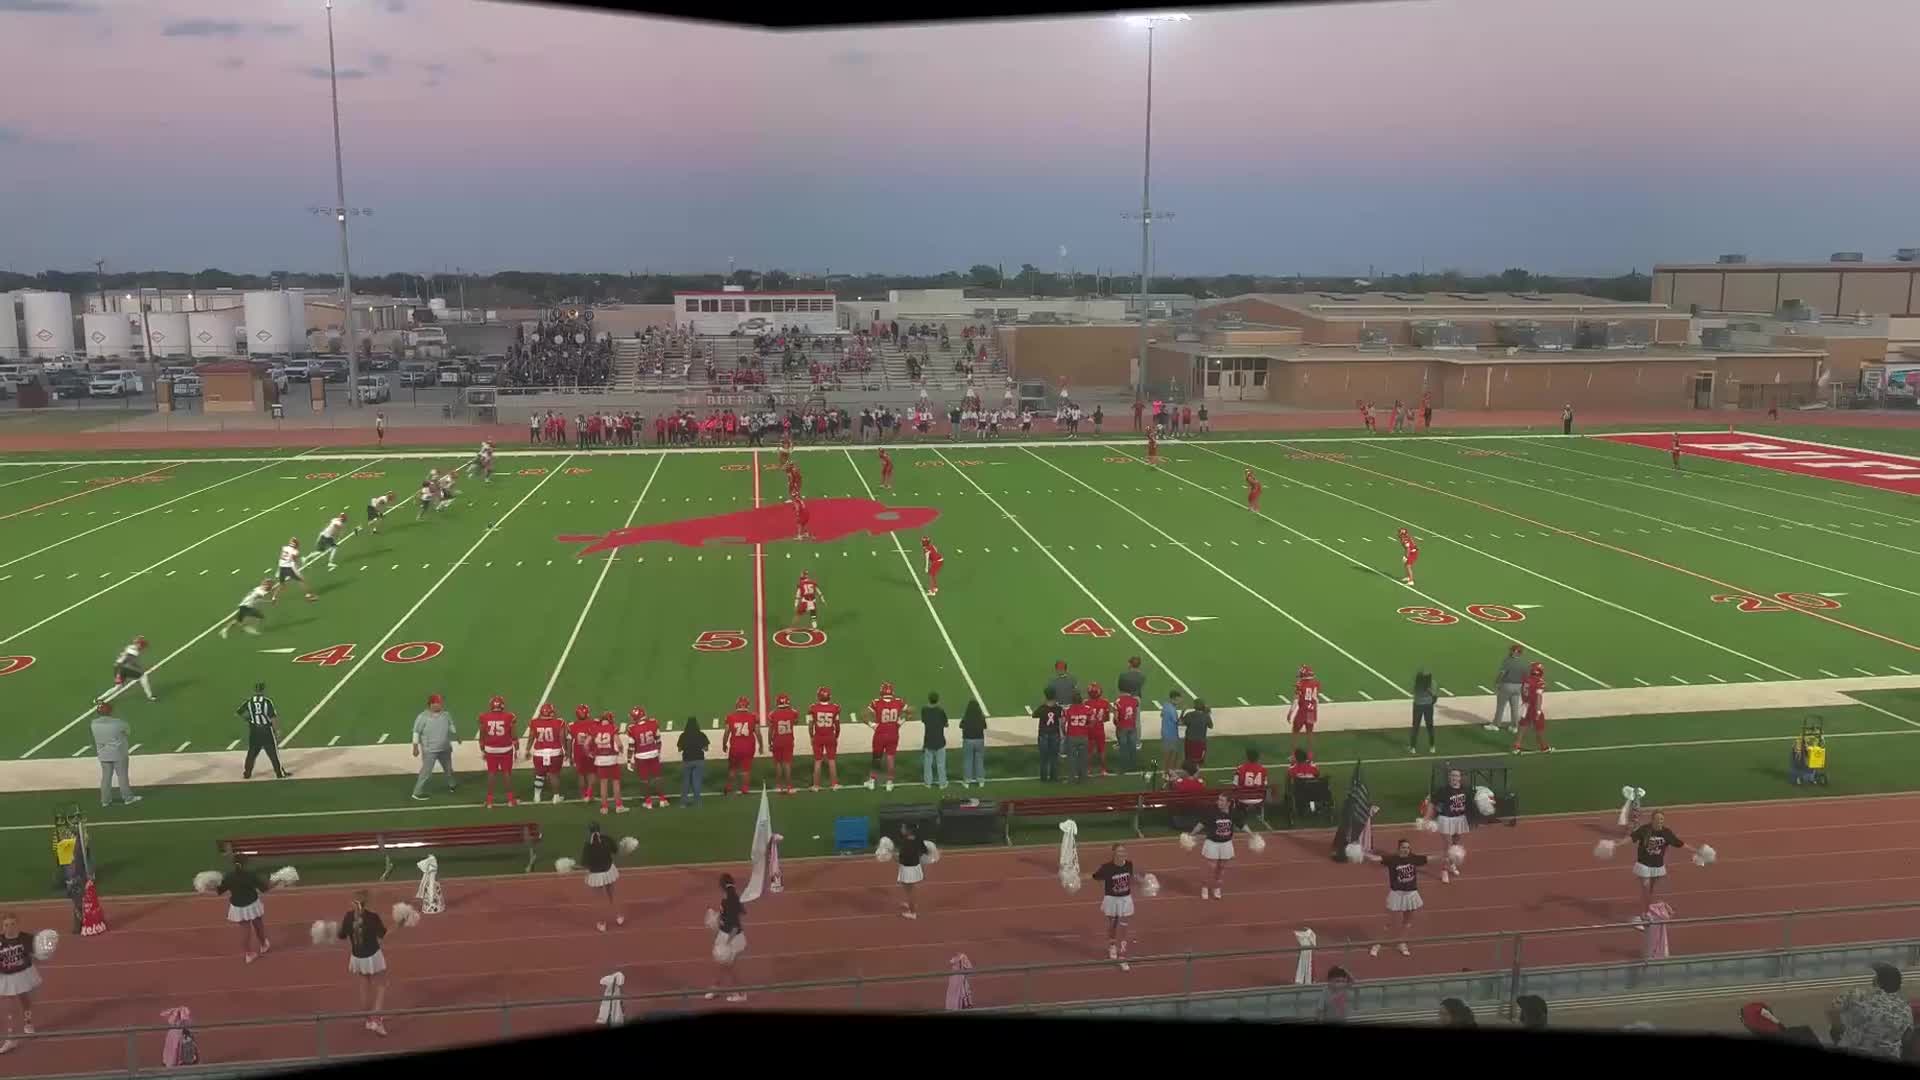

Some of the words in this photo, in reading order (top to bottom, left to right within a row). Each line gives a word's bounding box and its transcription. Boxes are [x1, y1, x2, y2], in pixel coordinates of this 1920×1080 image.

[816, 711, 834, 728] 55
[487, 720, 505, 736] 75
[734, 722, 750, 737] 74
